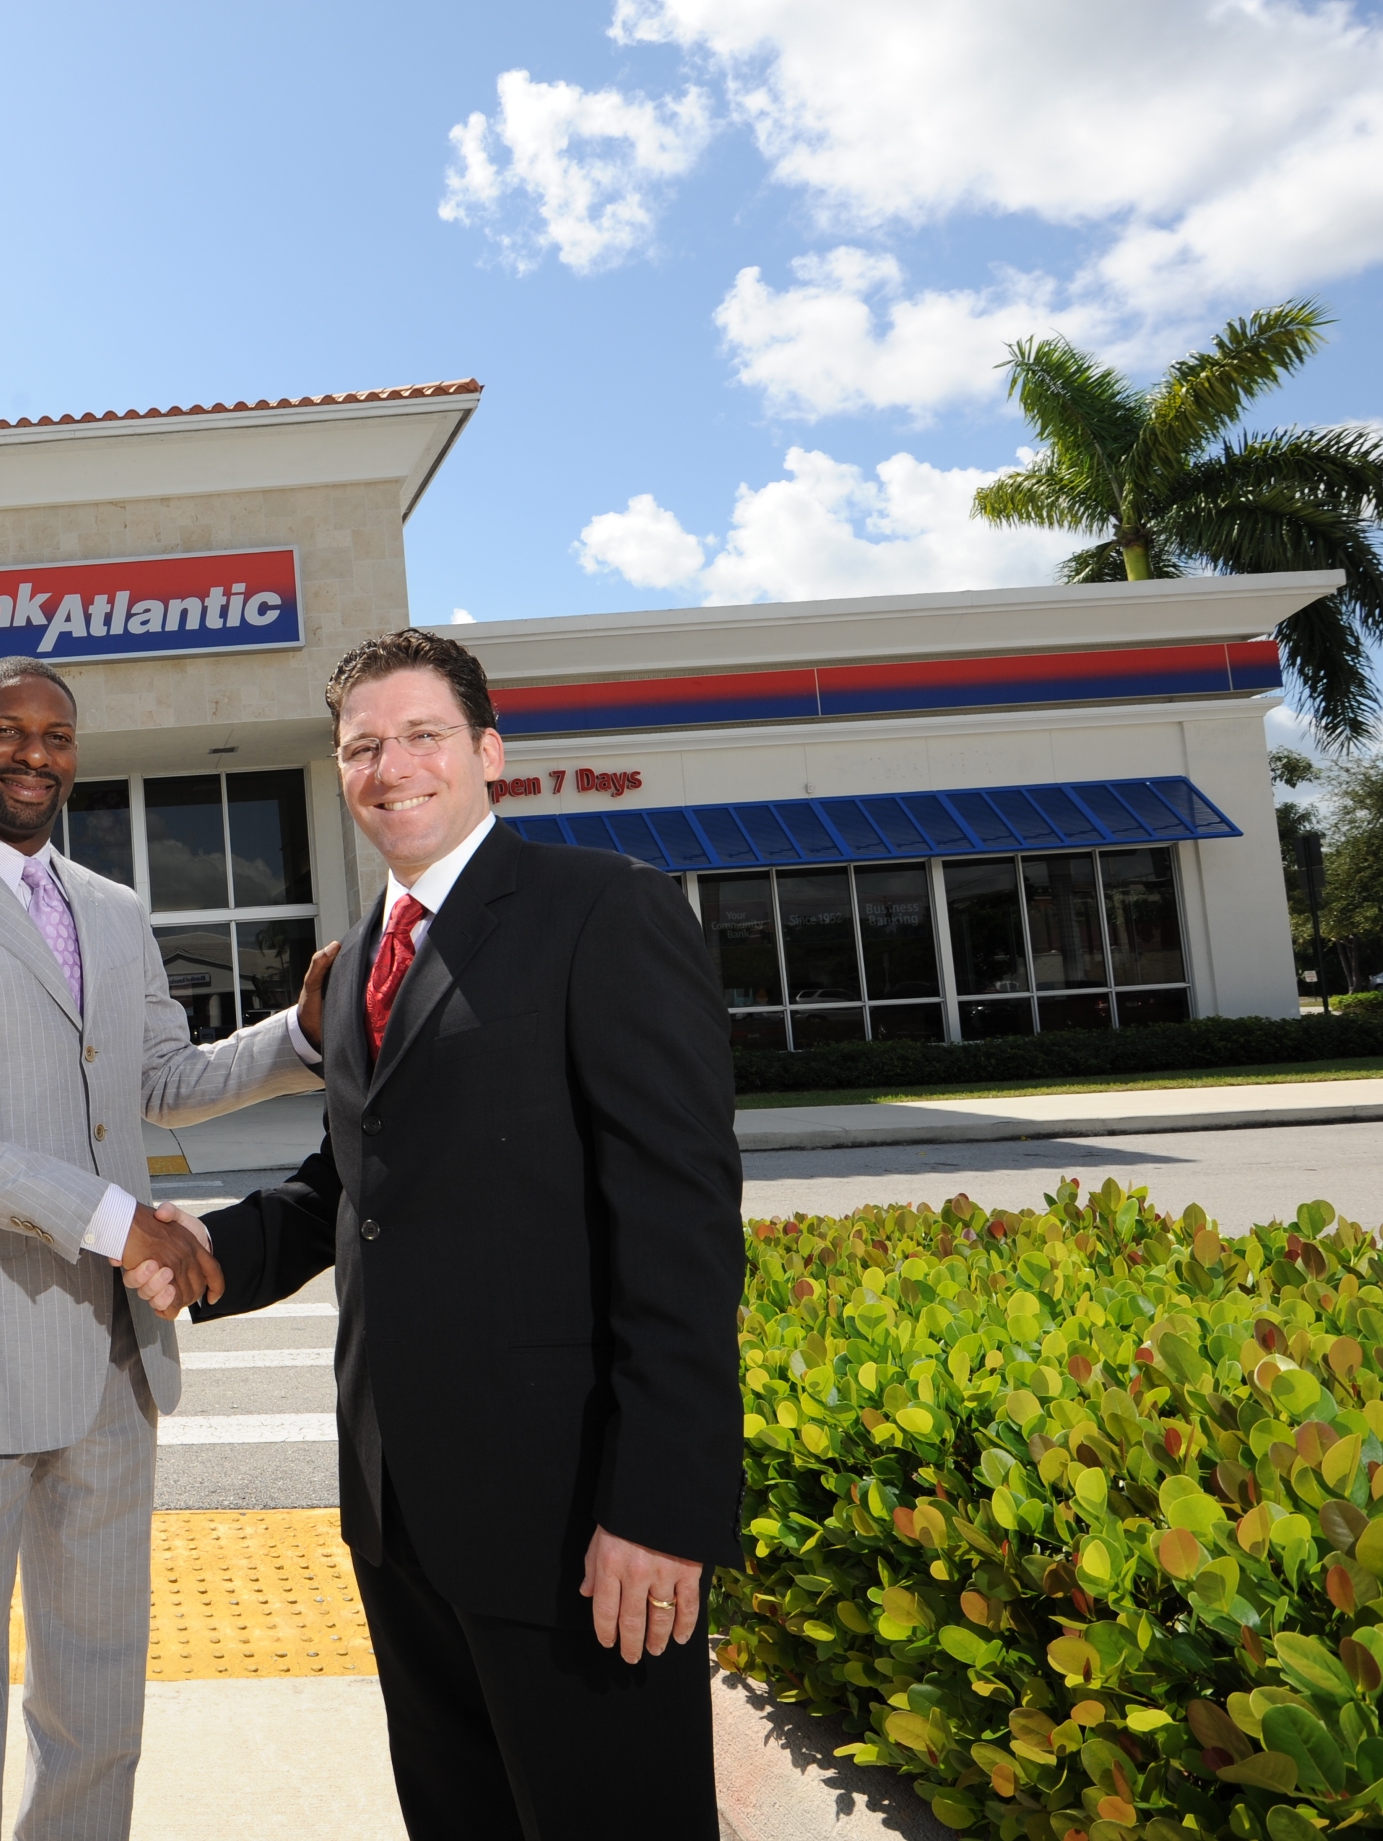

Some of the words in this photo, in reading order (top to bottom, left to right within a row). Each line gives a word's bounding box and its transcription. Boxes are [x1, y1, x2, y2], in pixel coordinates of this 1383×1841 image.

[490, 776, 542, 805] pen
[549, 769, 567, 795] 7
[575, 767, 643, 798] Days
[865, 903, 919, 915] Business
[725, 911, 747, 921] Your
[789, 914, 816, 926] Since
[817, 912, 842, 925] 1952
[868, 913, 919, 927] Banking
[711, 920, 765, 931] Community
[727, 929, 750, 939] Bank
